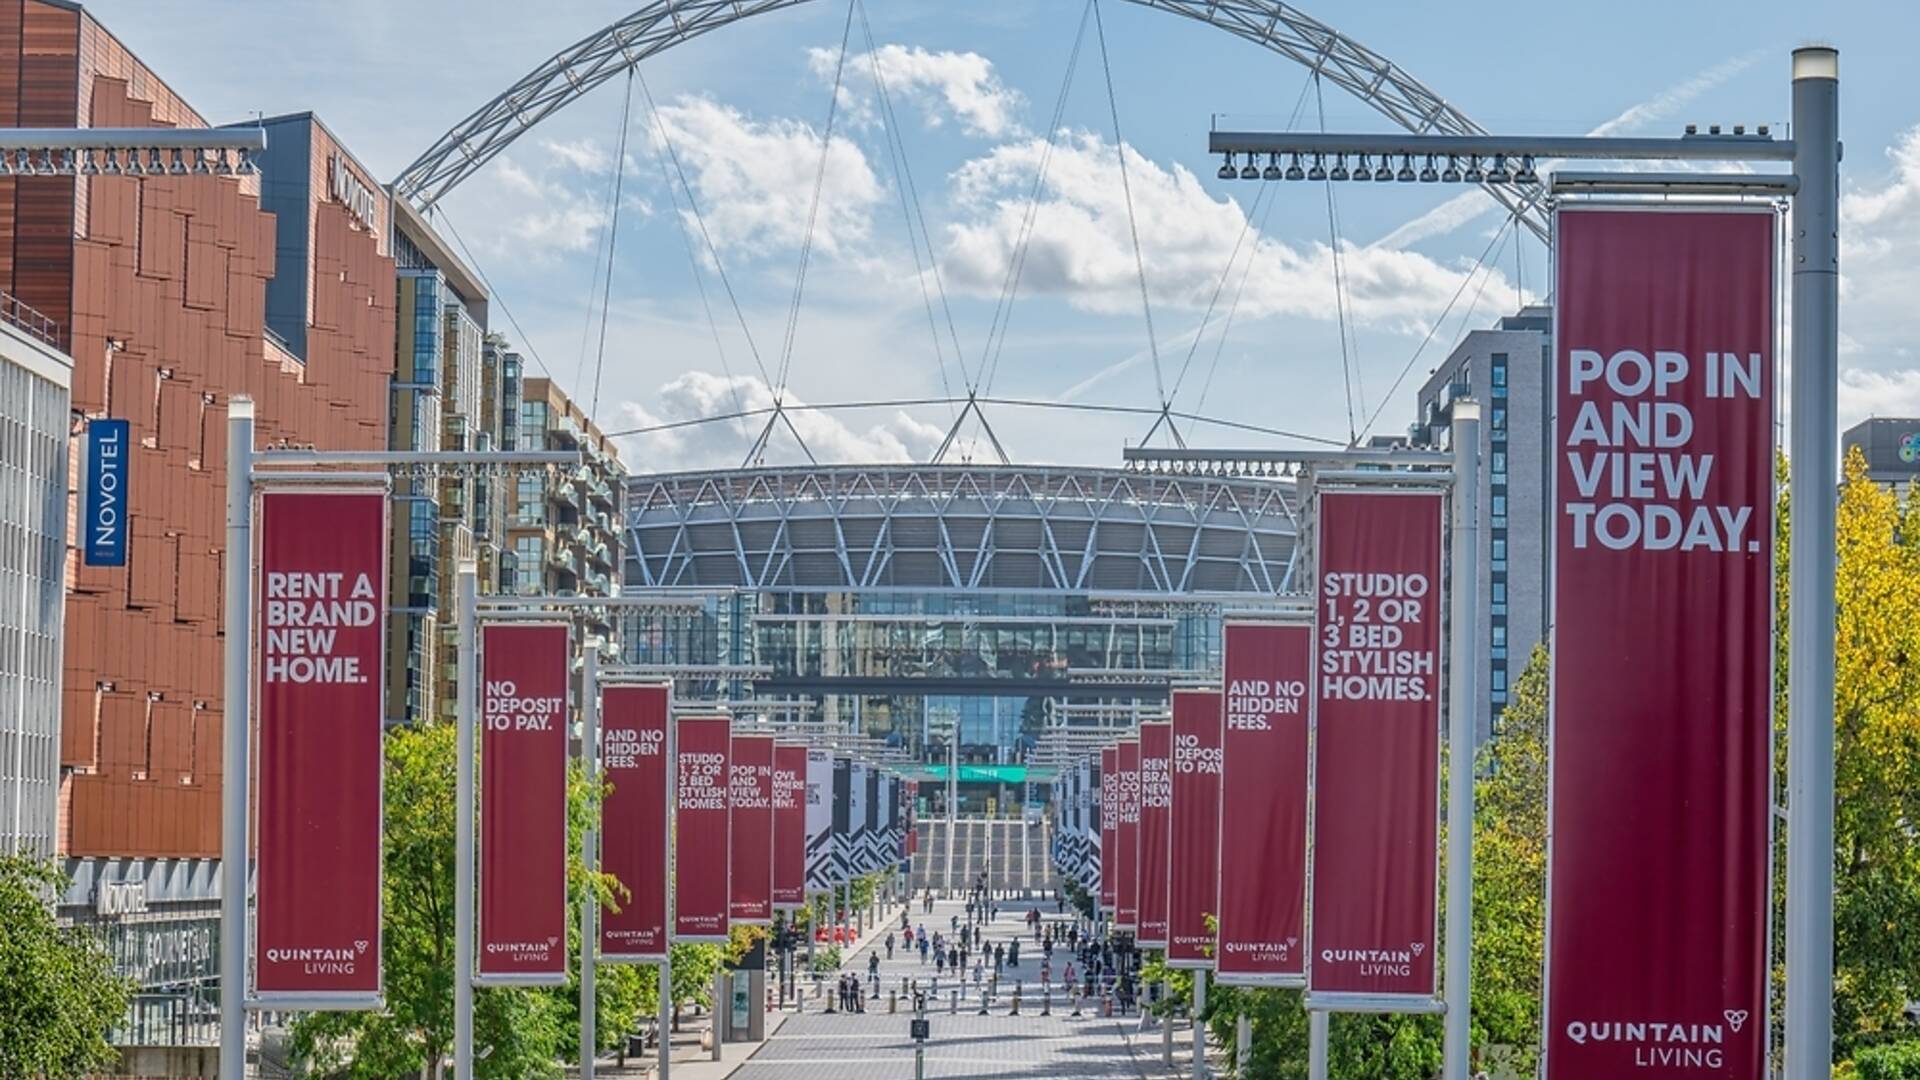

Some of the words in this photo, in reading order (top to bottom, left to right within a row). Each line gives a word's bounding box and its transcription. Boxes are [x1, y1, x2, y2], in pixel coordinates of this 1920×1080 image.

[1570, 350, 1689, 397] POP
[1706, 353, 1761, 398] IN
[1567, 401, 1693, 448] AND
[1567, 452, 1713, 500] VIEW
[96, 429, 118, 545] NOVOTEL
[1566, 503, 1760, 552] TODAY.
[268, 573, 343, 598] RENT
[351, 573, 375, 598] A
[1324, 573, 1428, 597] STUDIO
[268, 601, 376, 626] BRAND
[1326, 599, 1345, 626] 1,
[1353, 600, 1370, 622] 2
[1378, 600, 1421, 623] OR
[267, 629, 336, 654] NEW
[1323, 624, 1340, 648] 3
[1350, 625, 1403, 648] BED
[1323, 651, 1433, 675] STYLISH
[267, 657, 367, 683] HOME.
[486, 681, 516, 696] NO
[1228, 681, 1270, 696] AND
[1276, 681, 1305, 697] NO
[1322, 676, 1432, 700] HOMES.
[486, 698, 562, 713] DEPOSIT
[1228, 698, 1298, 713] HIDDEN
[486, 715, 510, 730] TO
[516, 715, 552, 730] PAY.
[1228, 714, 1272, 730] FEES.
[605, 729, 637, 742] AND
[641, 729, 664, 742] NO
[1176, 735, 1199, 747] NO
[605, 743, 658, 755] HIDDEN
[1175, 748, 1221, 760] DEPOS
[605, 756, 639, 768] FEES.
[679, 753, 725, 765] STUDIO
[1142, 759, 1169, 770] REN
[692, 766, 700, 775] 2
[702, 766, 722, 776] OR
[730, 766, 756, 776] POP
[758, 766, 771, 776] IN
[1175, 761, 1194, 773] TO
[680, 776, 688, 786] 3
[690, 776, 714, 786] BED
[731, 776, 757, 786] AND
[1142, 771, 1169, 782] BRA
[679, 787, 727, 798] STYLISH
[731, 787, 761, 797] VIEW
[679, 799, 727, 809] HOMES.
[731, 799, 770, 808] TODAY.
[606, 930, 654, 939] QUINTAIN
[487, 943, 548, 953] QUINTAIN
[1226, 942, 1288, 952] QUINTAIN
[267, 948, 354, 963] QUINTAIN
[513, 953, 548, 961] LIVING
[1252, 952, 1288, 961] LIVING
[1322, 949, 1410, 963] QUINTAIN
[304, 963, 354, 975] LIVING
[1360, 964, 1410, 976] LIVING
[1566, 1021, 1723, 1044] QUINTAIN
[1635, 1048, 1723, 1068] LIVING
